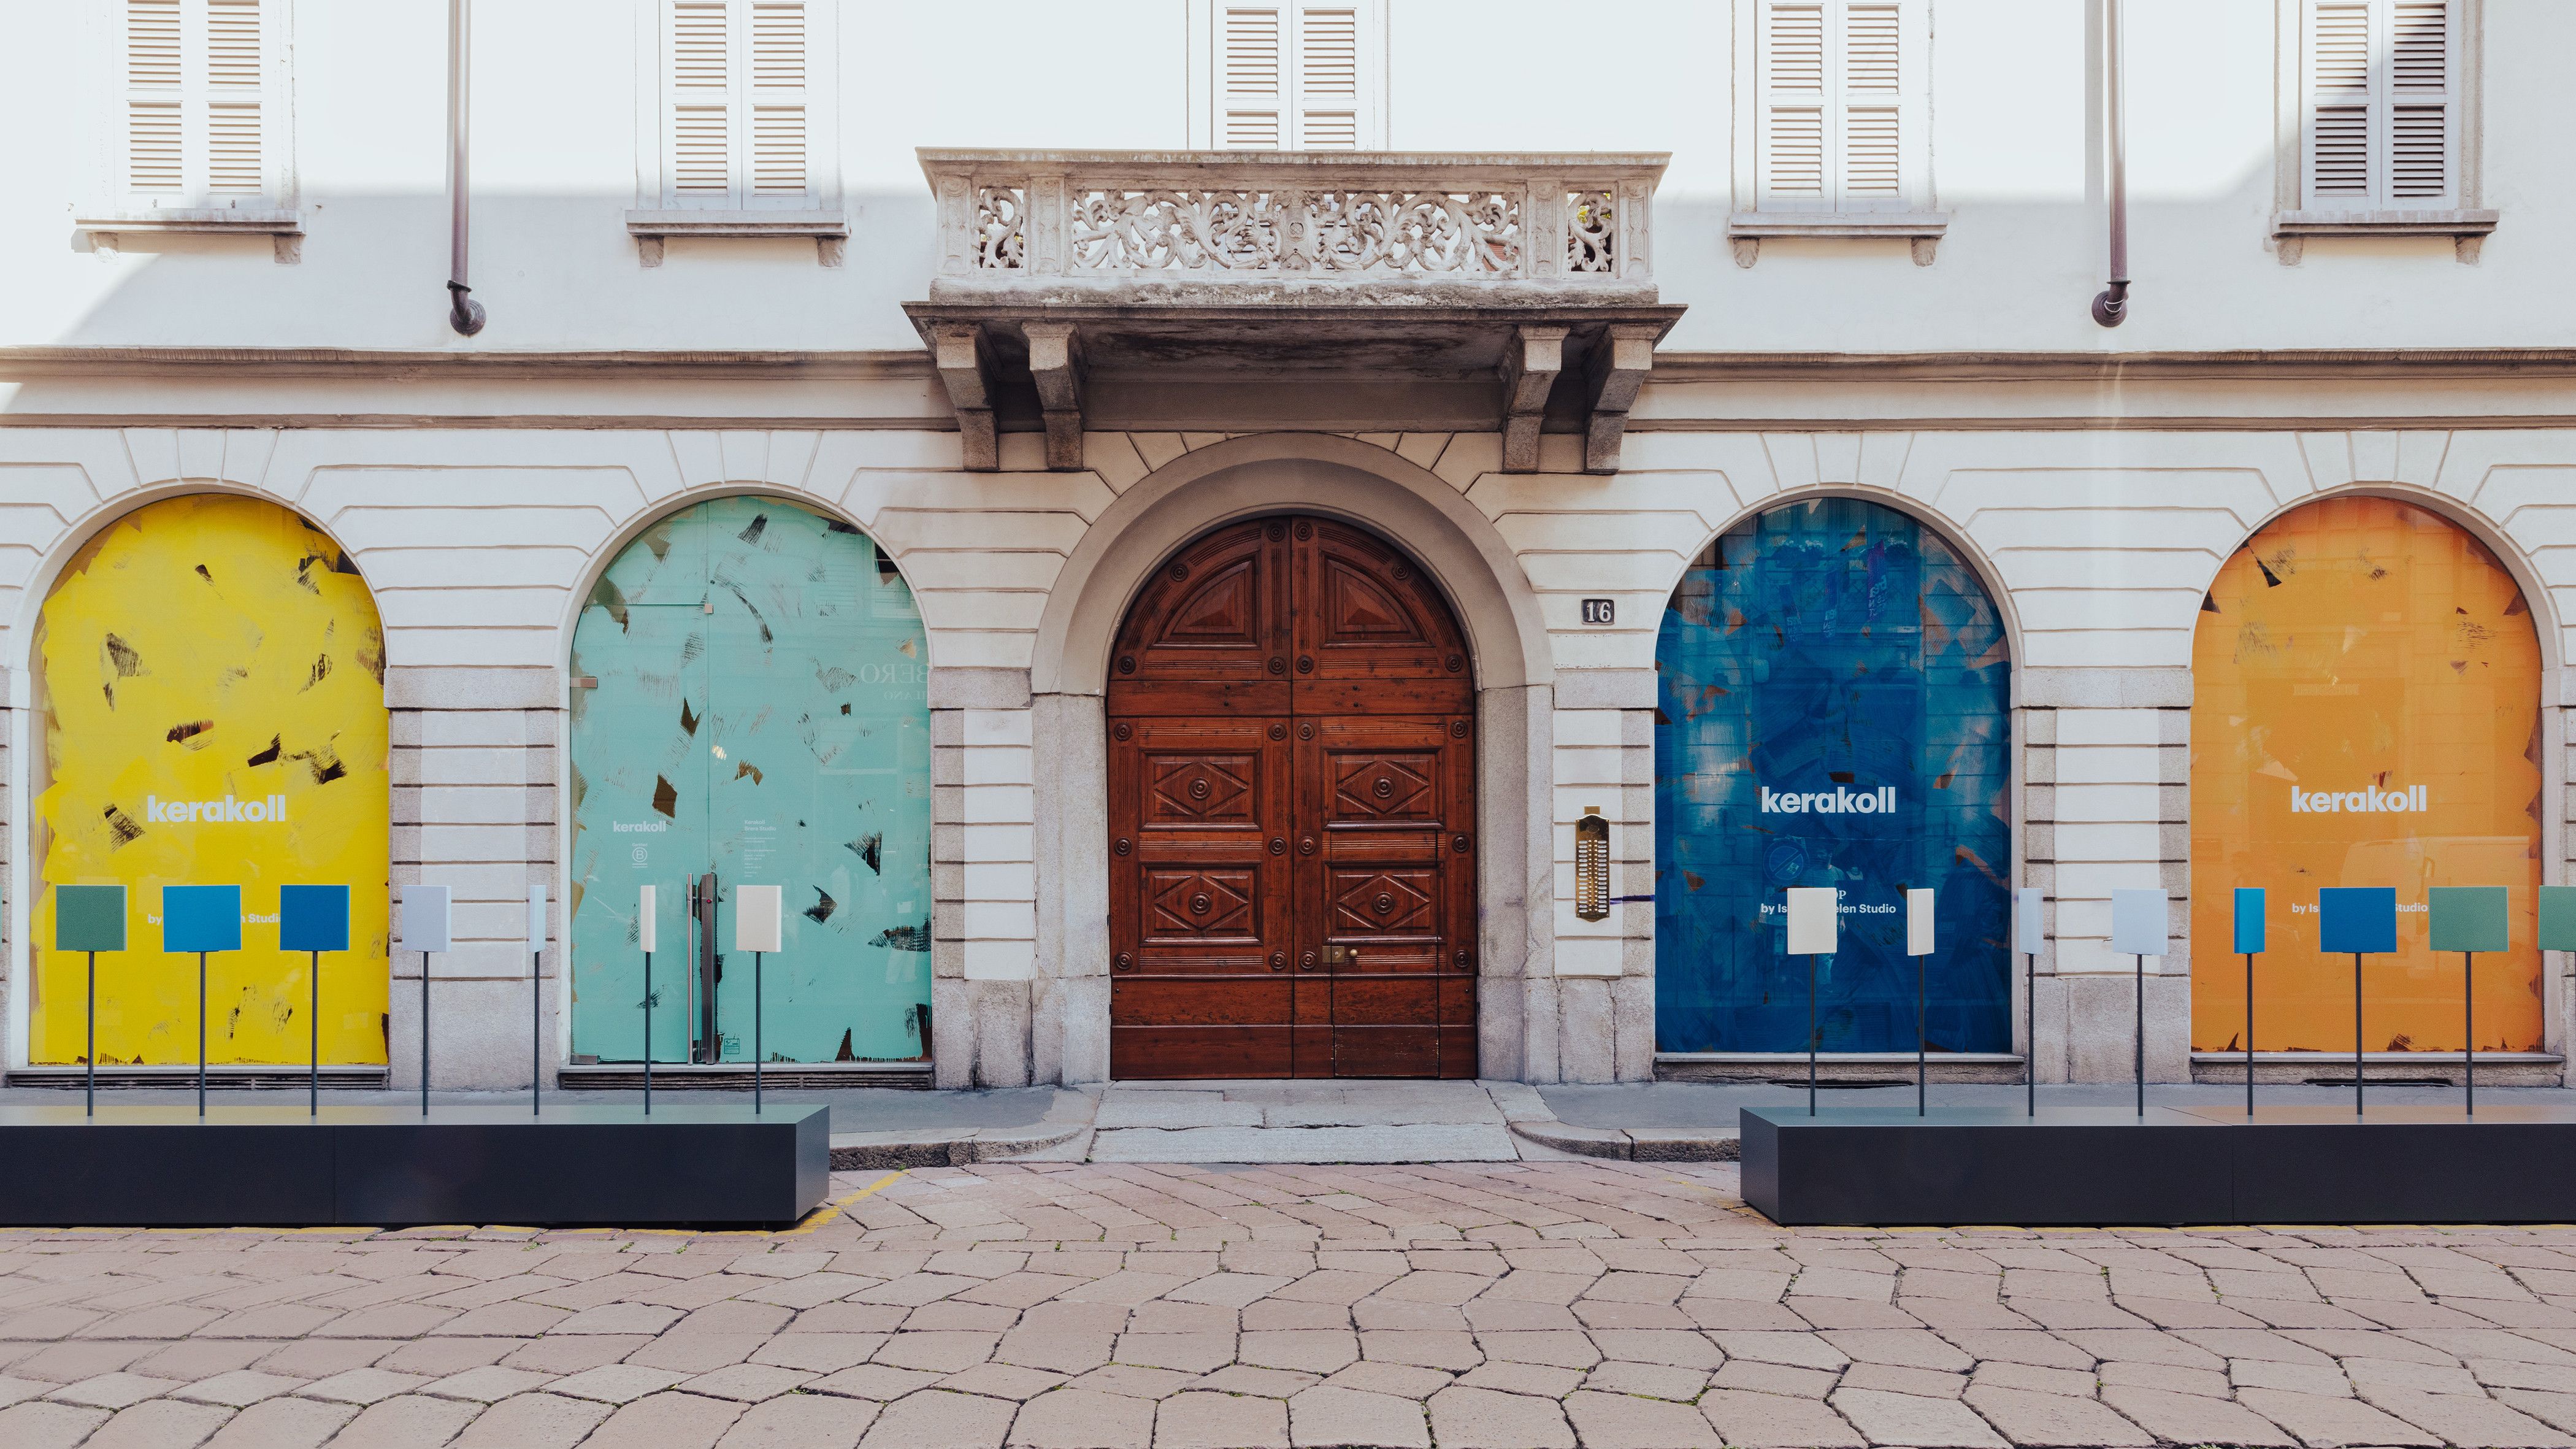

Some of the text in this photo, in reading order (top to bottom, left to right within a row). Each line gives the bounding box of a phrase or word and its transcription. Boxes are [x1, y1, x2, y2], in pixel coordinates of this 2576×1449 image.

[1587, 601, 1612, 622] 16
[1761, 786, 1896, 813] kerakoll
[2291, 785, 2426, 812] kerakoll
[147, 794, 286, 823] kerakoll
[613, 821, 667, 832] kerakoll
[1760, 903, 1775, 915] by
[1859, 903, 1897, 913] Studio
[2292, 902, 2307, 915] by
[148, 913, 163, 925] by
